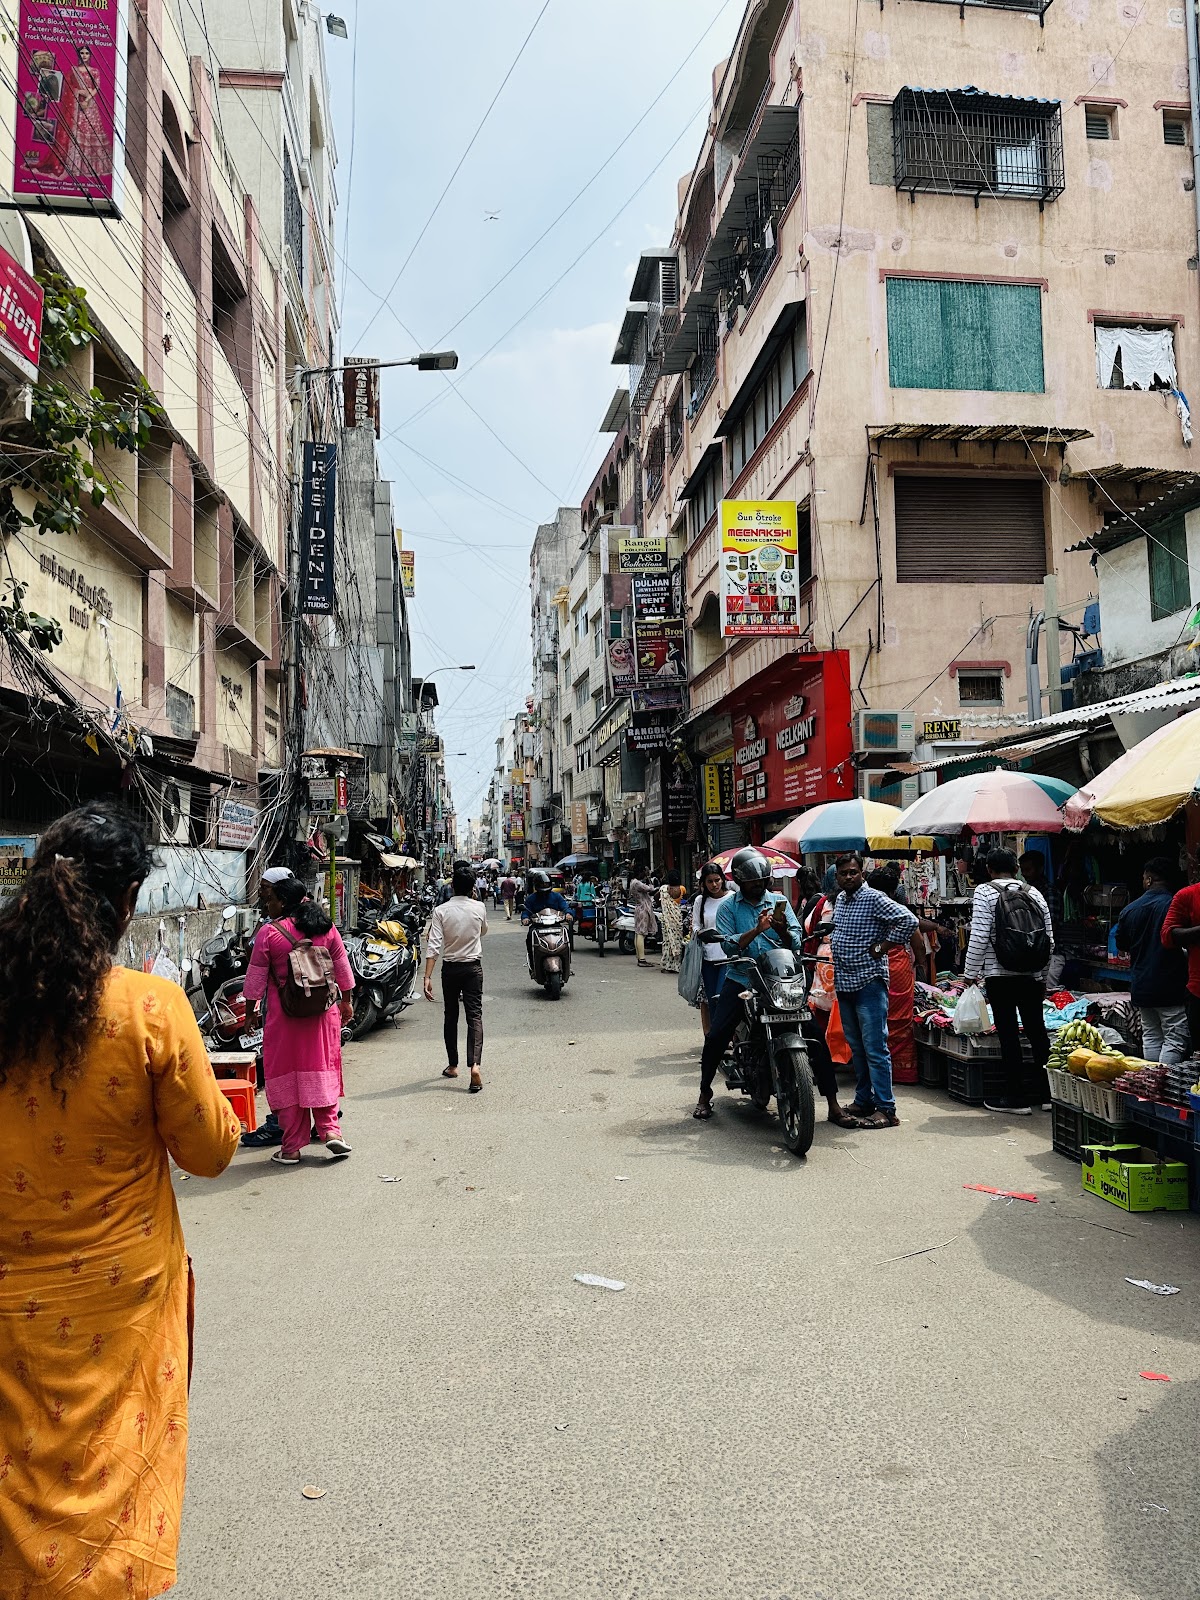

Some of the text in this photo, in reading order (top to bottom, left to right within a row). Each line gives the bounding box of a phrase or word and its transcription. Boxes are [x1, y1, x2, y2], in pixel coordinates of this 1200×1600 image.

[309, 444, 327, 590] PRESIDENT
[737, 512, 782, 522] Sun Stroke
[727, 528, 792, 537] MEENAKSHI
[623, 538, 661, 548] Rangoli
[637, 553, 663, 562] A&D
[635, 578, 670, 588] DULHAN
[642, 606, 666, 614] SALE
[636, 628, 663, 638] Samra
[924, 720, 959, 734] RENT
[776, 715, 814, 752] NEELKANT
[924, 732, 947, 740] BRIDAL
[735, 737, 766, 766] MEENAKSHI
[575, 803, 583, 833] DENTAL
[0, 867, 13, 876] 1st
